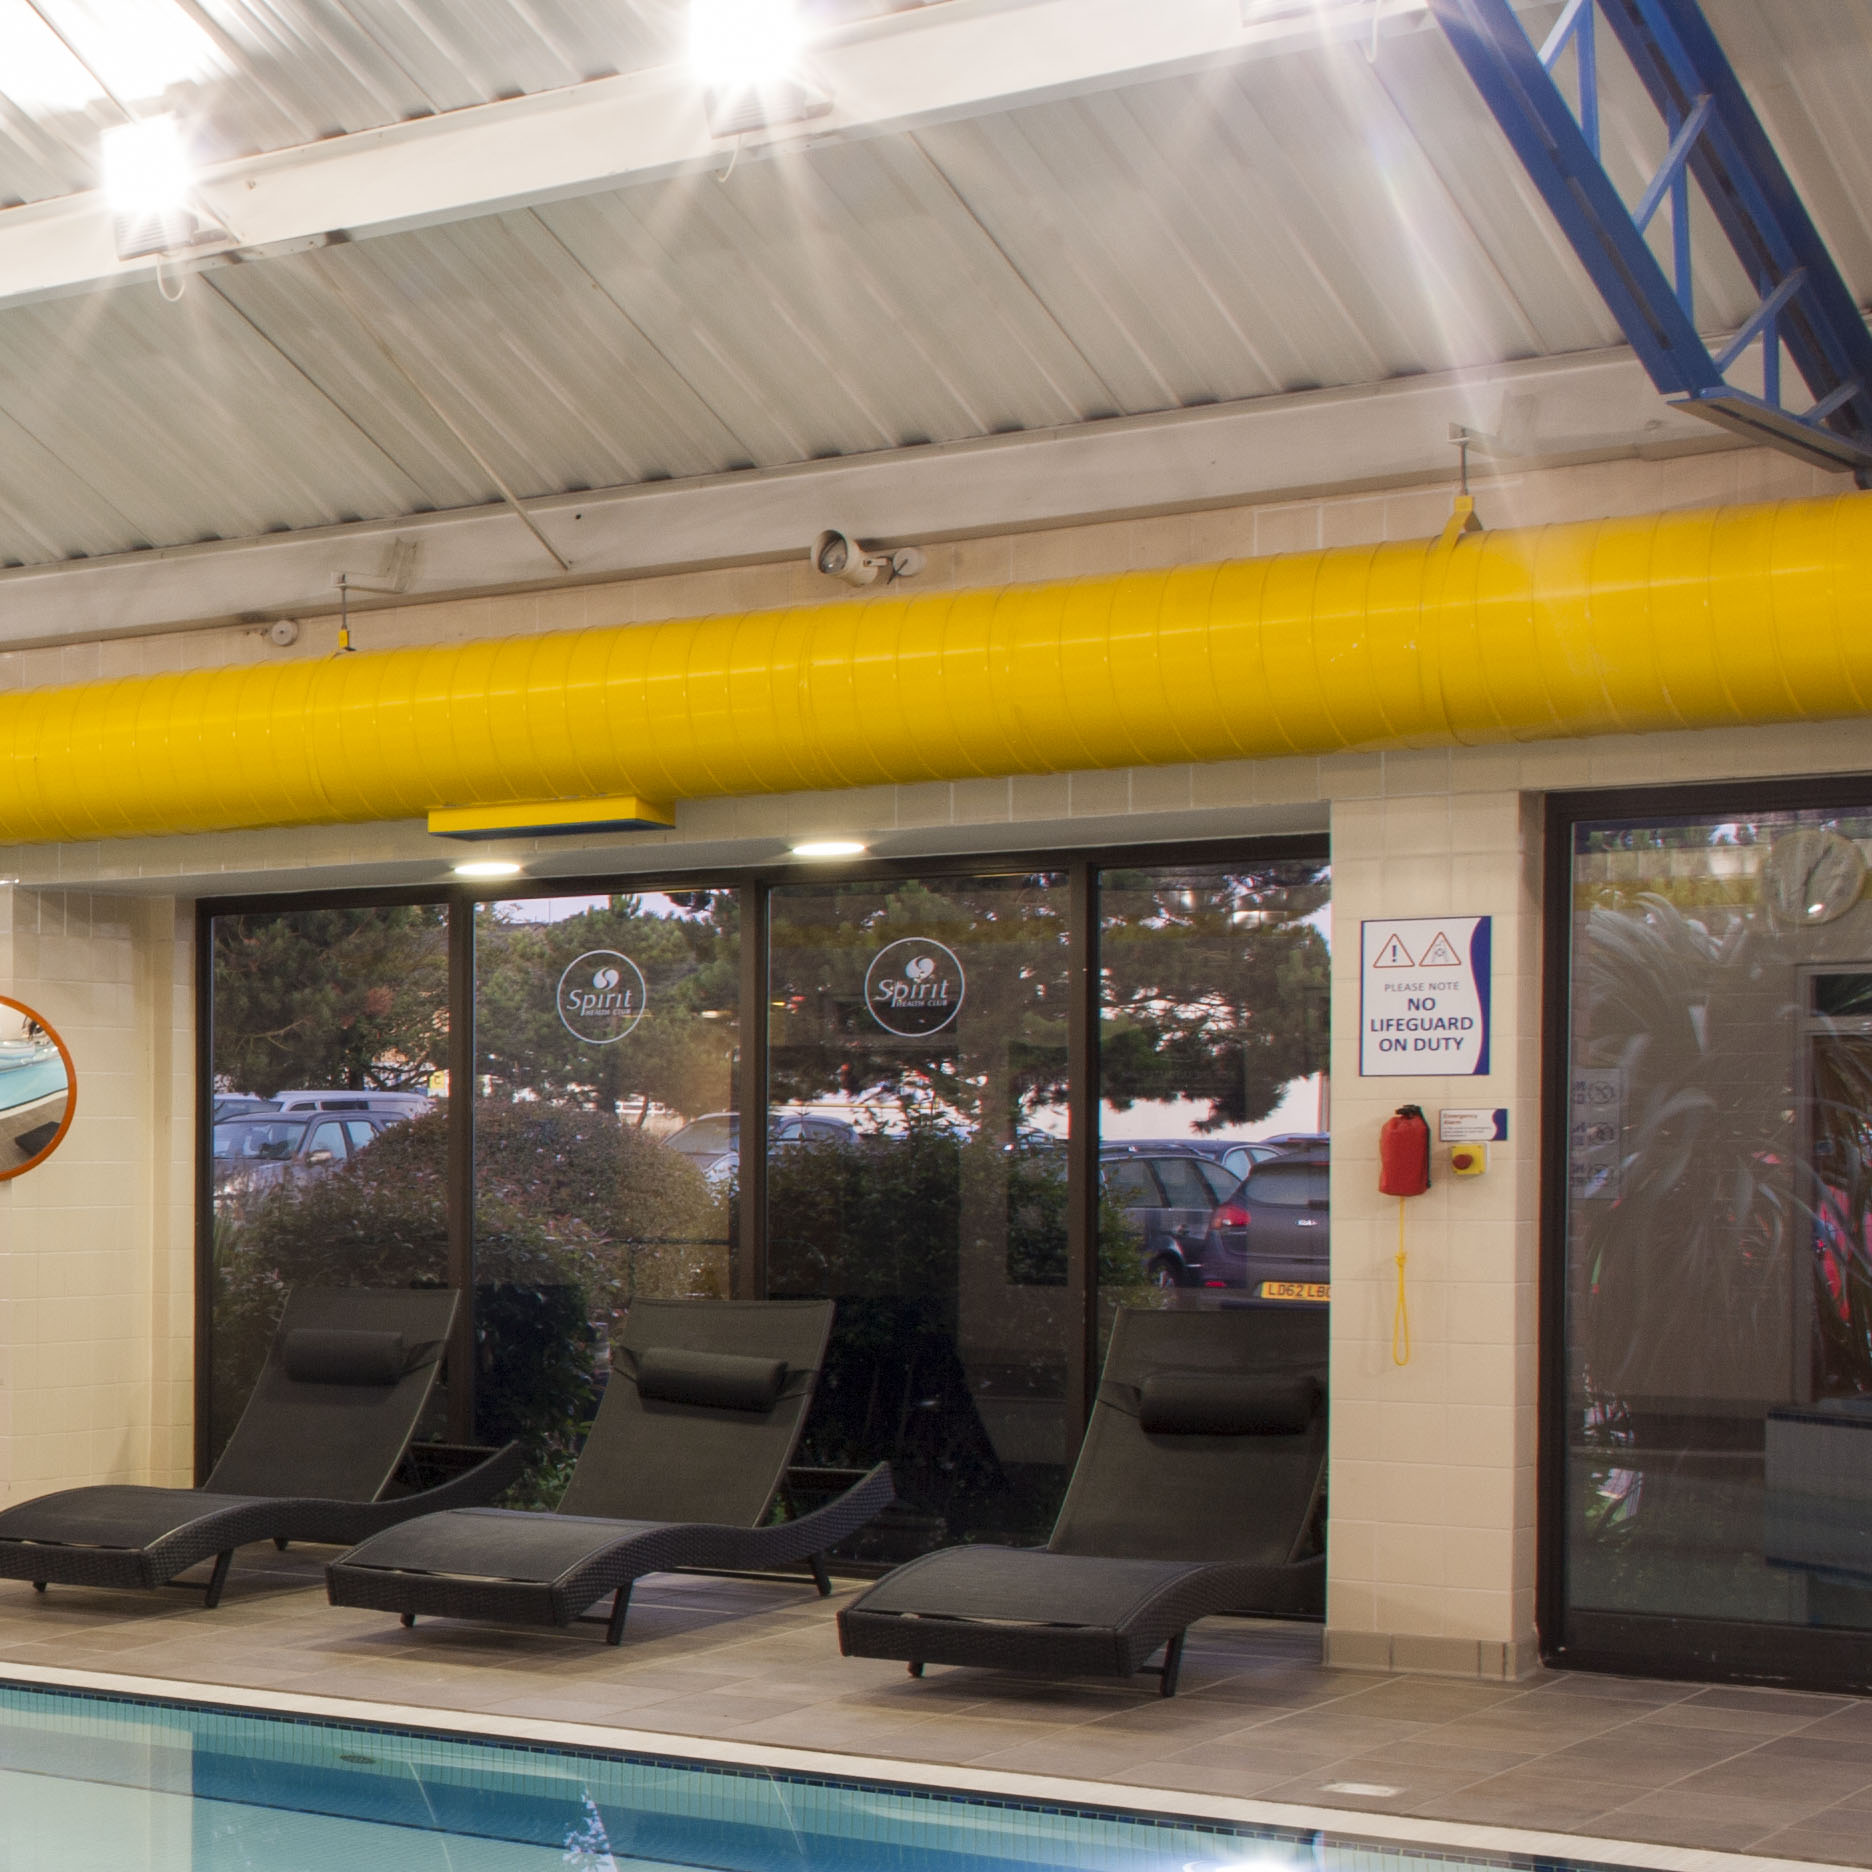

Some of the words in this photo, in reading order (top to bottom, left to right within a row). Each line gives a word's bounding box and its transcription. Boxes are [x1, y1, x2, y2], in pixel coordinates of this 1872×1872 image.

[873, 978, 950, 1008] Spirit
[1384, 982, 1425, 992] PLEASE
[1428, 981, 1460, 991] NOTE
[566, 988, 633, 1017] Spirit
[1407, 997, 1436, 1011] NO
[1370, 1016, 1474, 1032] LIFEGUARD
[1378, 1038, 1408, 1052] ON
[1414, 1037, 1465, 1051] DUTY
